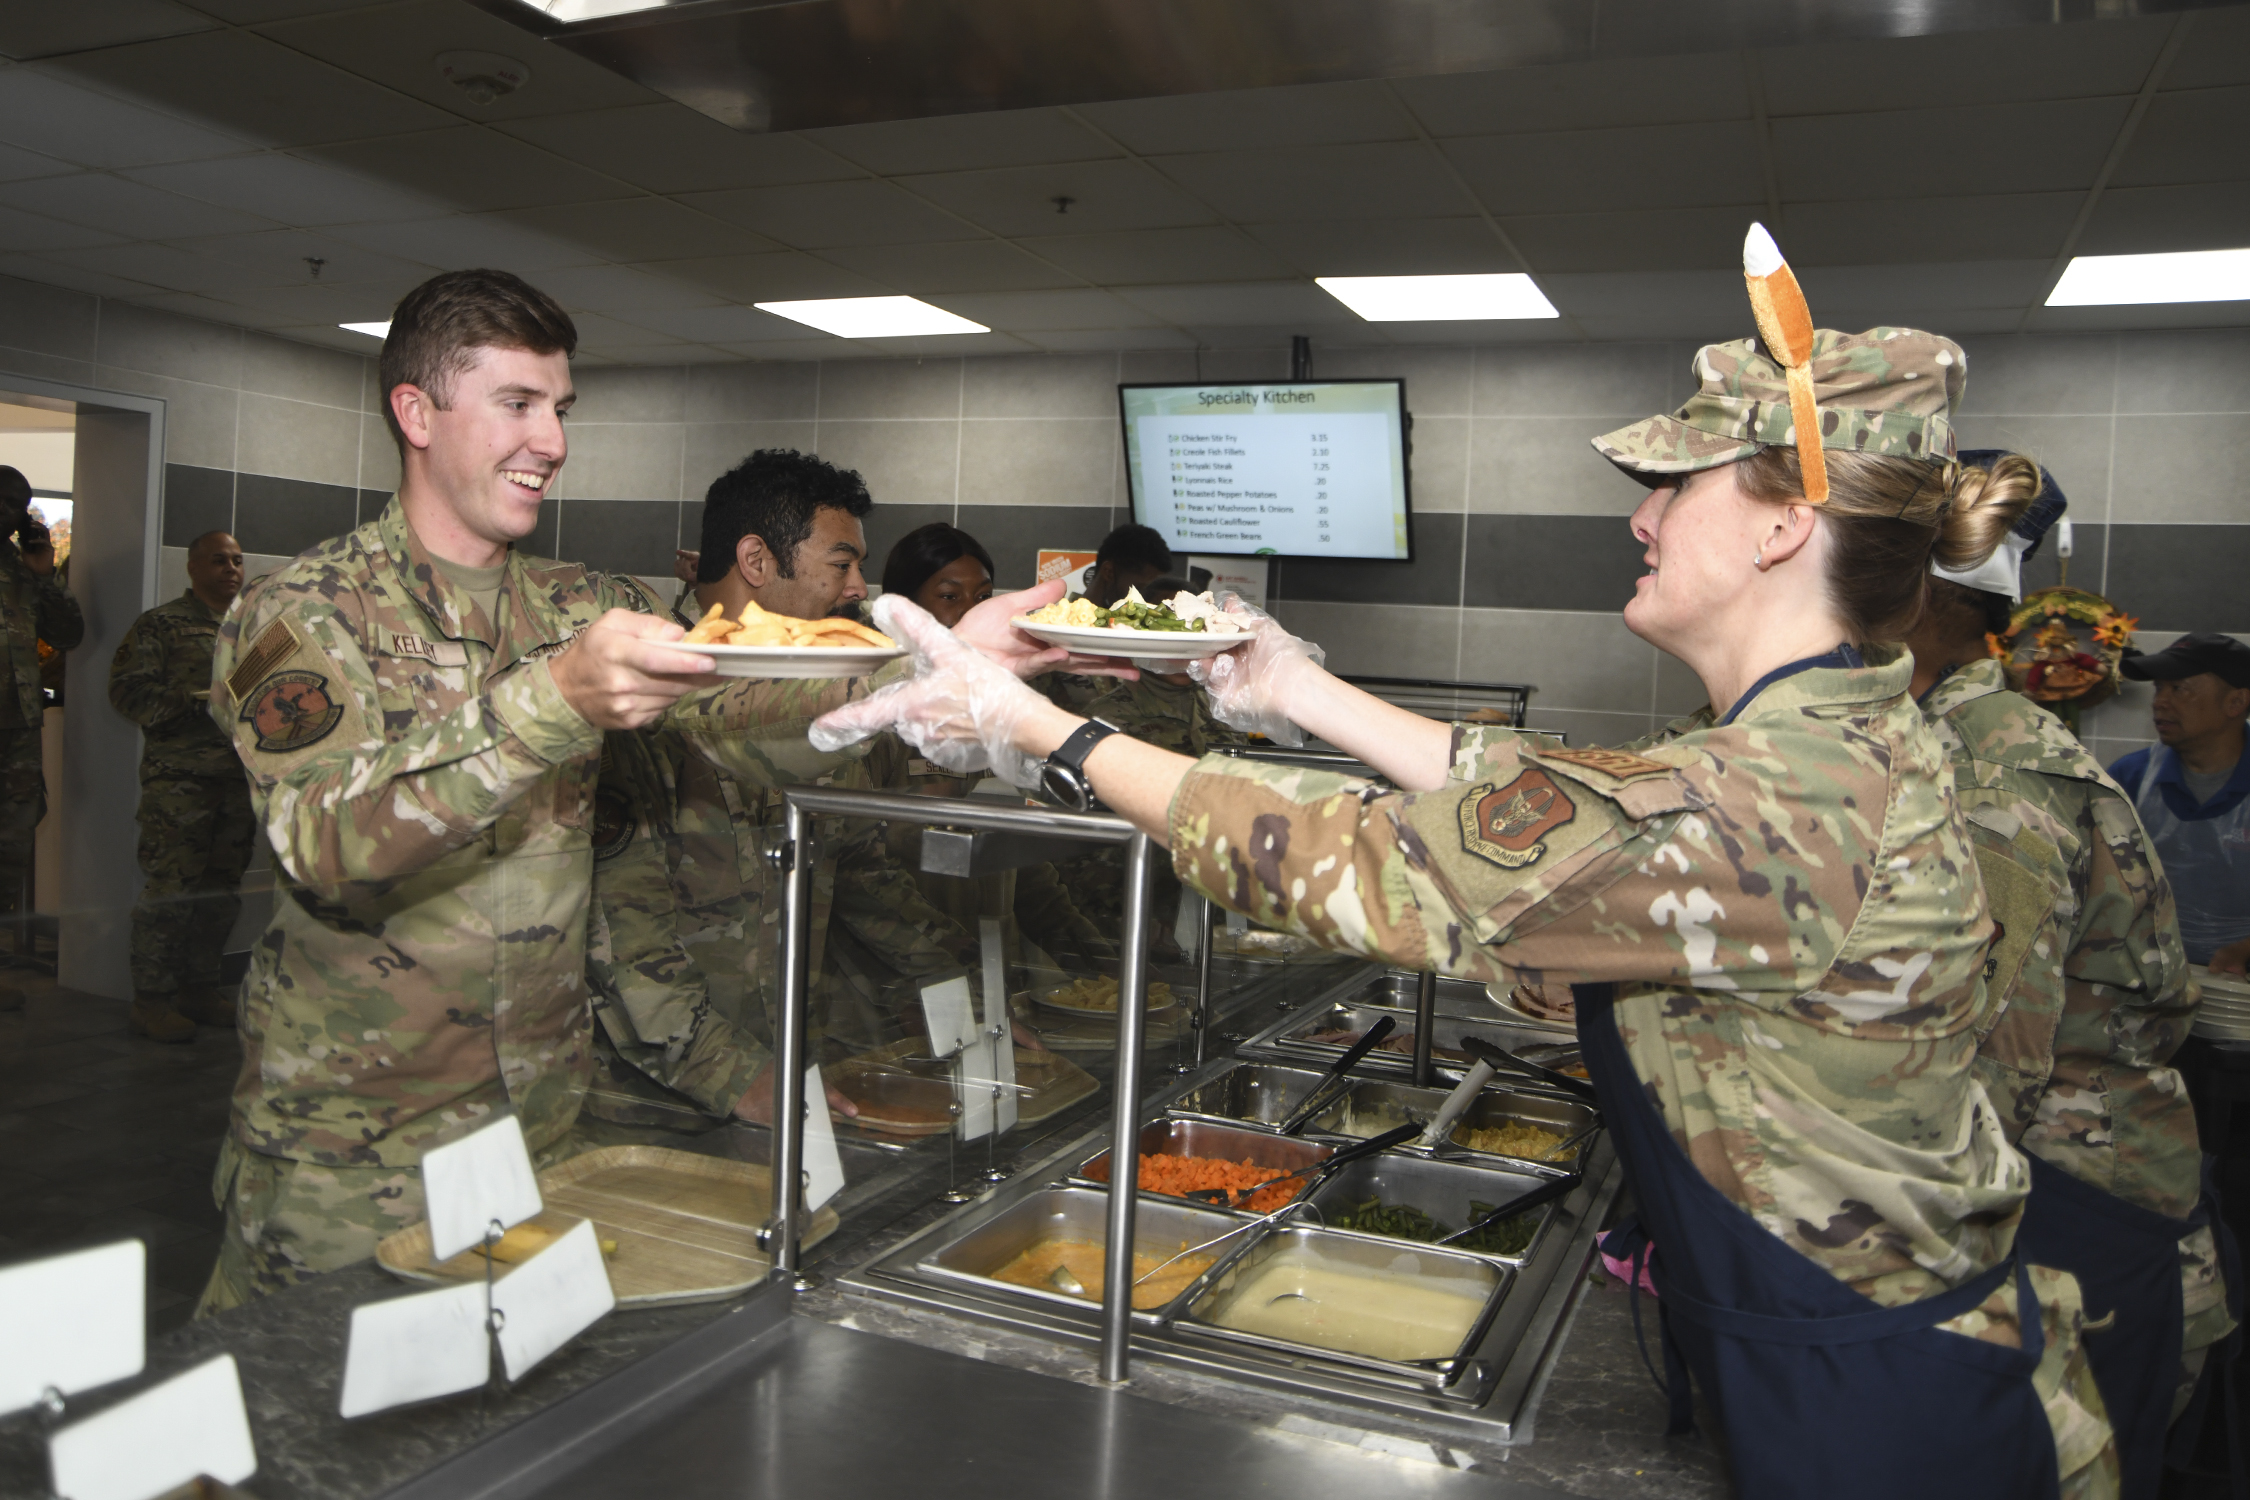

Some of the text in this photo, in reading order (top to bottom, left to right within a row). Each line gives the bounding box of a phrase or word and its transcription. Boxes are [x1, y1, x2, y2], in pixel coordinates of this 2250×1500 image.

[1198, 389, 1315, 407] Specialty Kitchen
[1181, 434, 1209, 442] Chicken
[1211, 434, 1223, 442] Stir
[1225, 434, 1237, 444] Fry
[1183, 448, 1205, 456] Creole
[1208, 448, 1222, 456] Fish
[1224, 448, 1246, 456] Fillets
[1184, 462, 1211, 472] Teriyaki
[1212, 462, 1233, 470] Steak
[1217, 476, 1233, 484] Rice
[1187, 490, 1215, 498] Roasted
[1217, 490, 1242, 499] Pepper
[1245, 491, 1278, 499] Potatoes
[1188, 504, 1204, 512] Peas
[1218, 504, 1257, 513] Mushroom
[1259, 504, 1266, 513] &
[1268, 505, 1294, 514] Onions
[1189, 517, 1218, 526] Roasted
[1220, 517, 1261, 527] Cauliflower
[1190, 531, 1215, 540] French
[1216, 532, 1239, 541] Green
[1240, 532, 1263, 541] Beans
[1038, 558, 1072, 580] SODIUM
[1487, 845, 1527, 866] COMMAND
